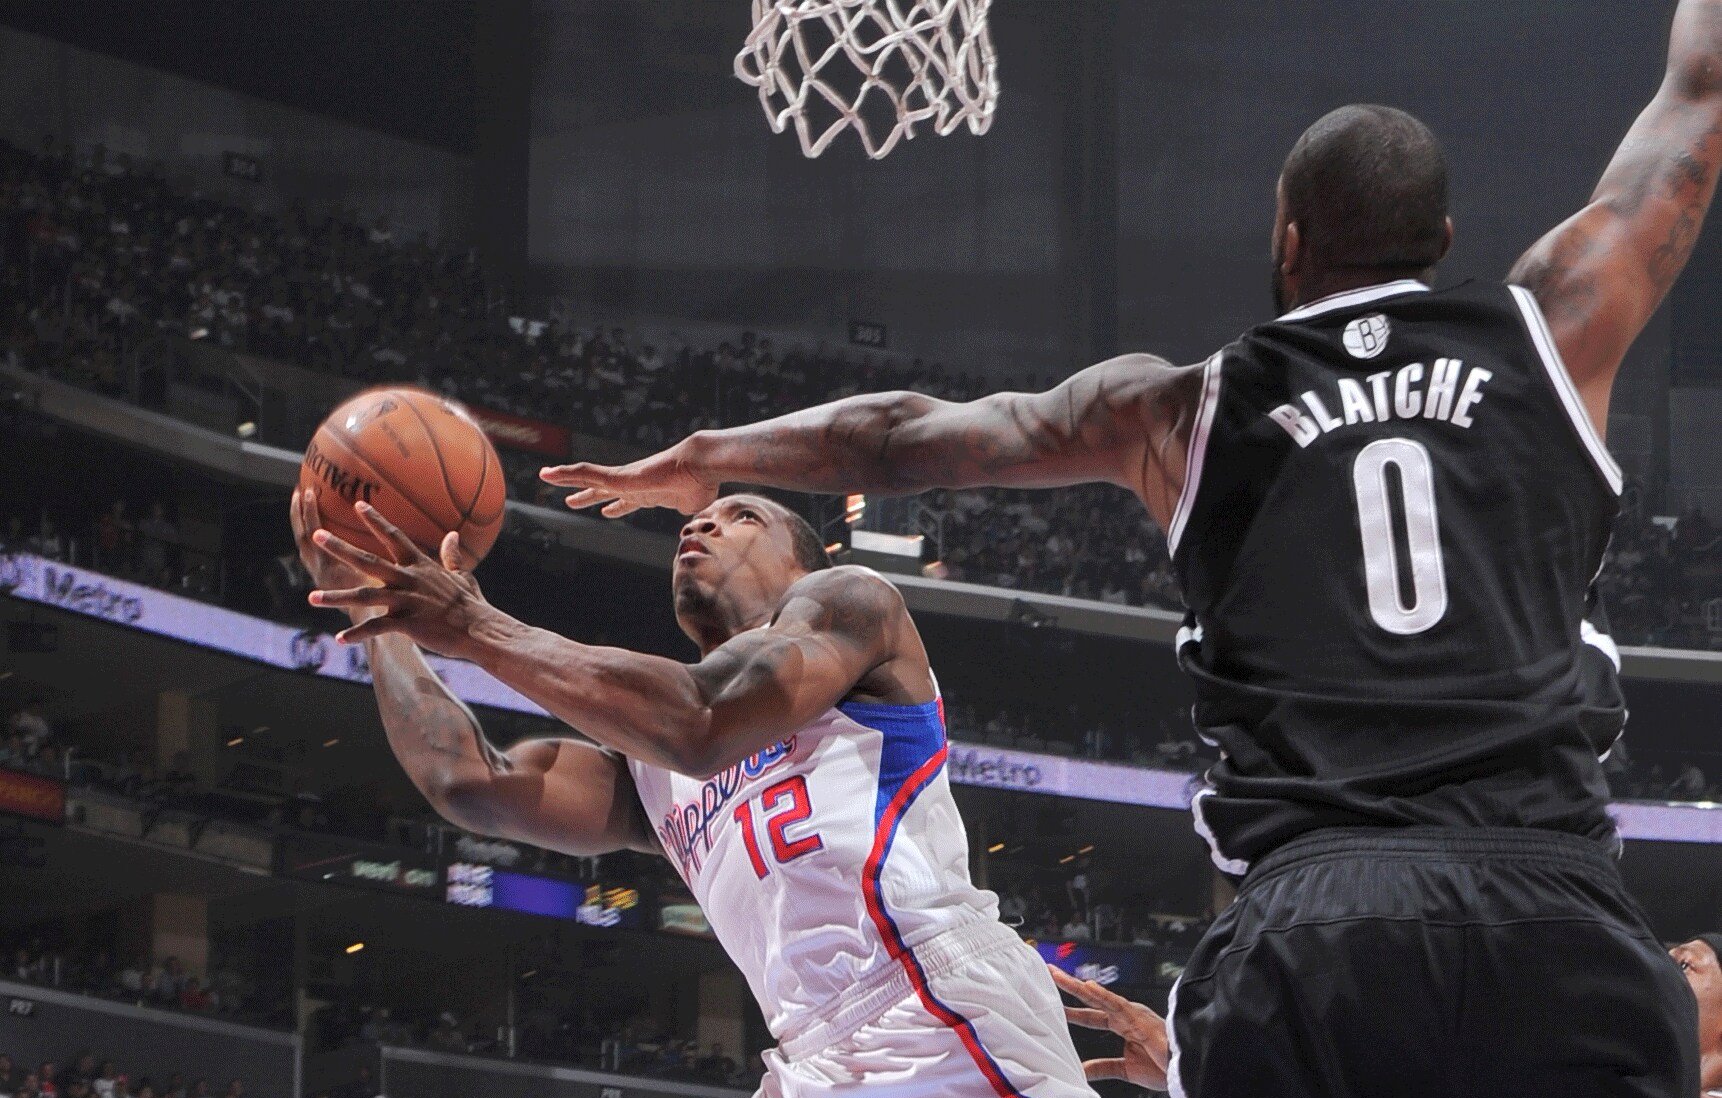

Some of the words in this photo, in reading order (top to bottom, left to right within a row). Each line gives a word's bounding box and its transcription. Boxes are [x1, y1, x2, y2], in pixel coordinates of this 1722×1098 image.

[1268, 357, 1493, 449] BLATCHE
[1353, 437, 1448, 635] 0
[947, 747, 1042, 787] Metro
[351, 859, 438, 888] verion
[733, 774, 824, 881] 12
